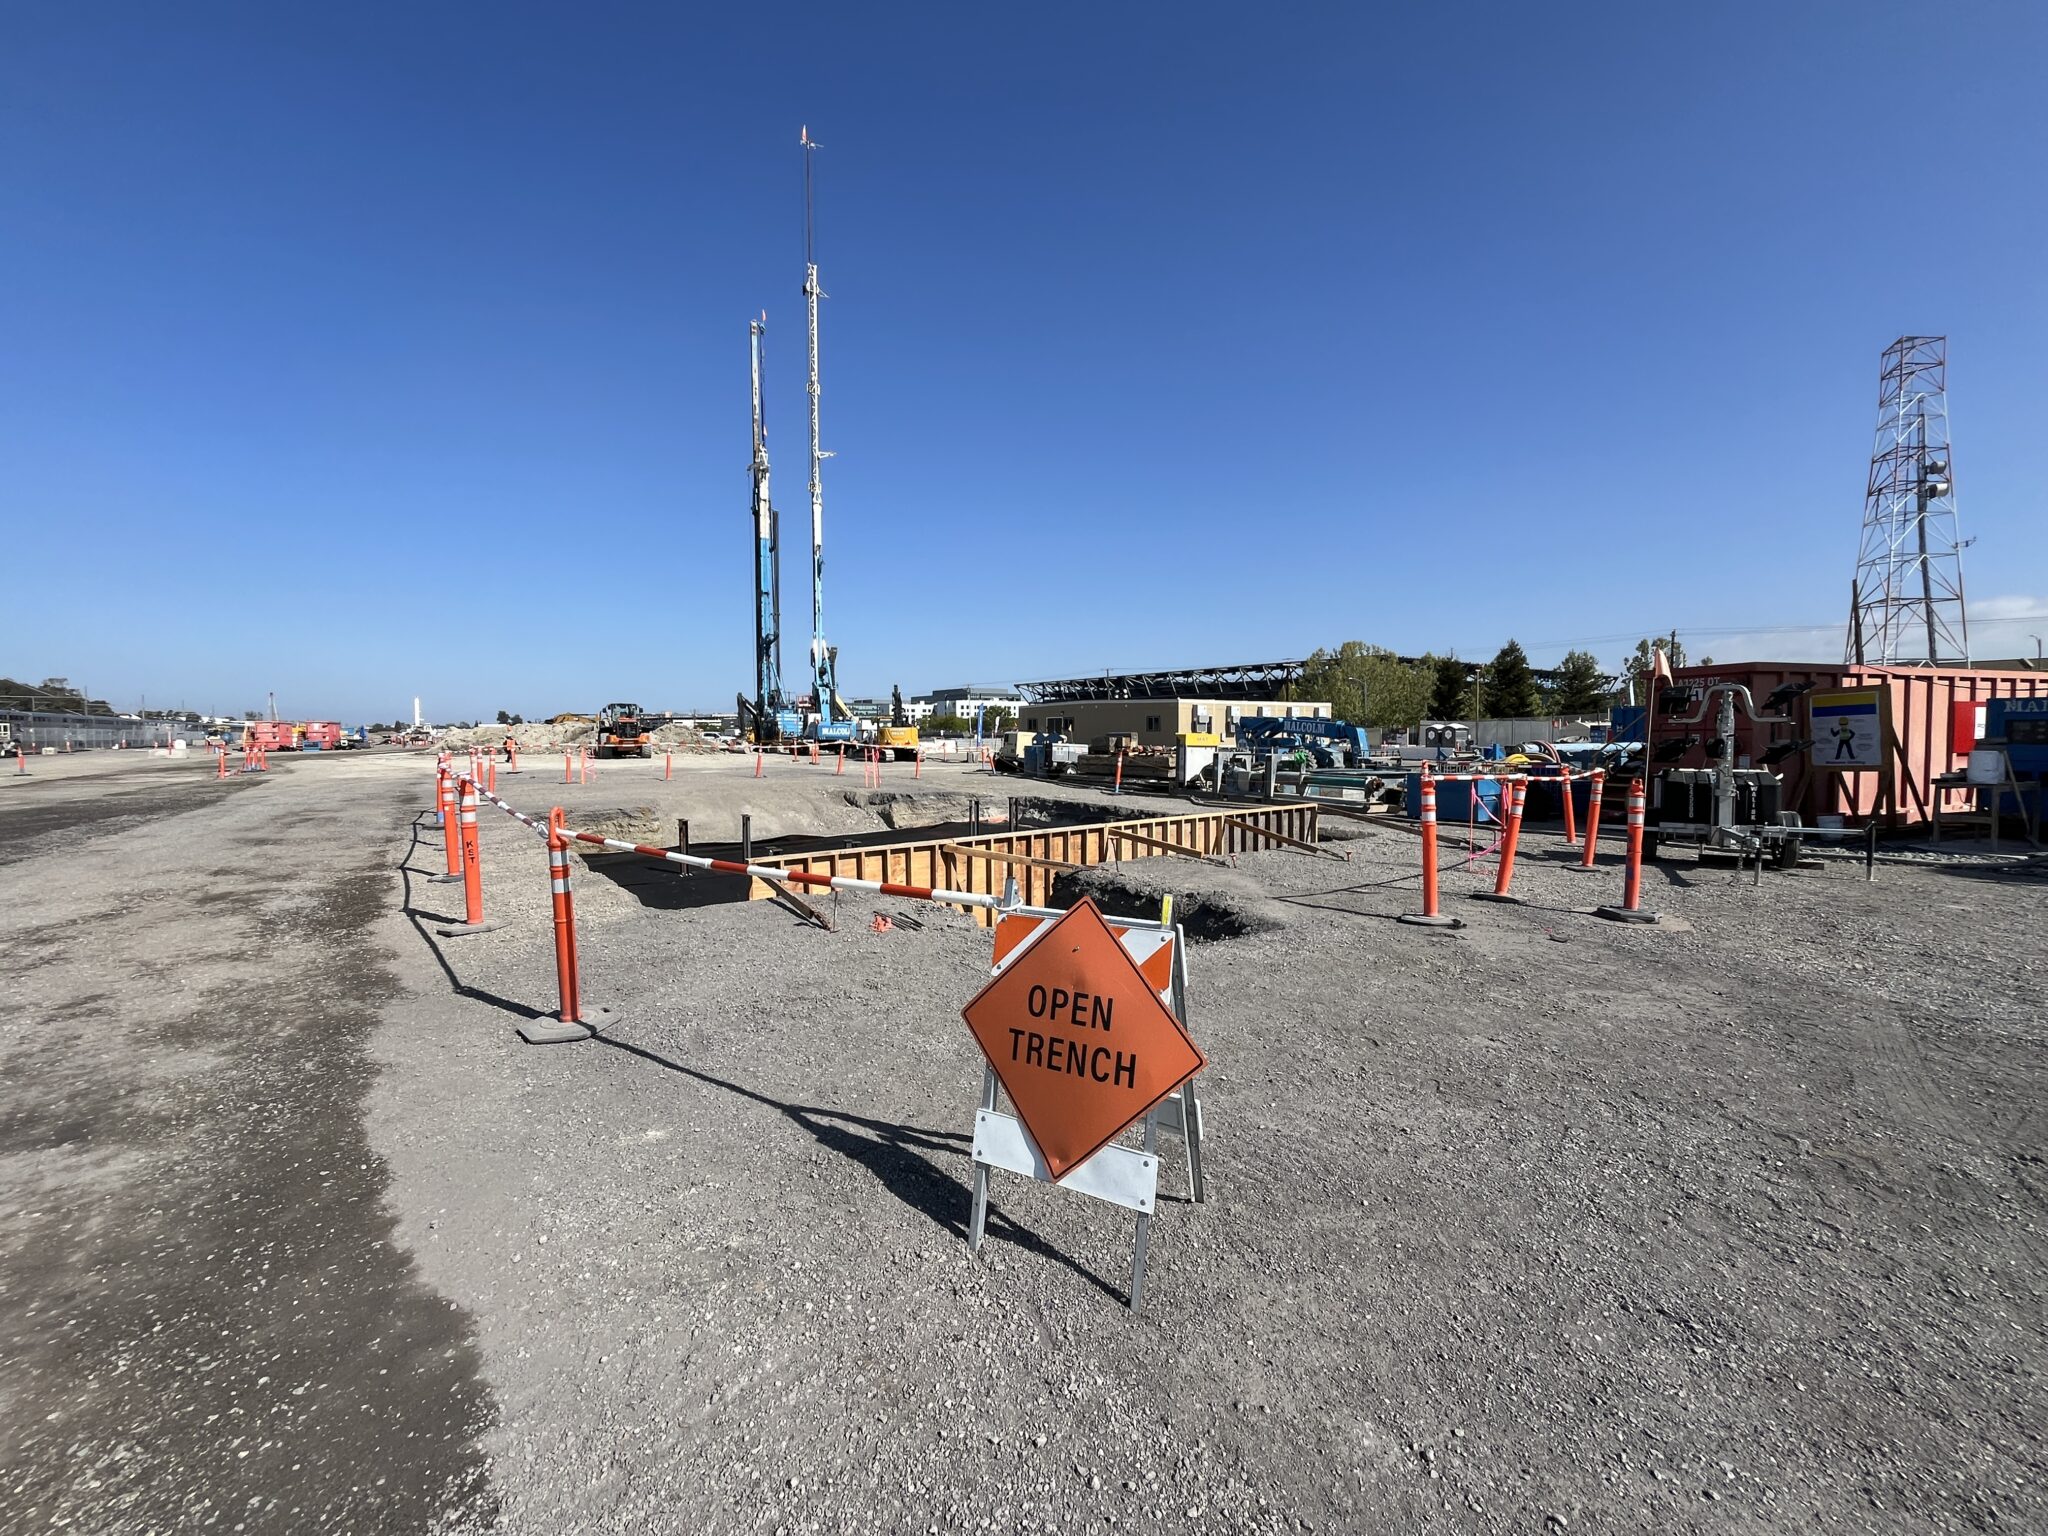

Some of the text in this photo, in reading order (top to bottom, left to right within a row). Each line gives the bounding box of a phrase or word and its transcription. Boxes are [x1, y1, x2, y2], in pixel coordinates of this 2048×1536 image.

[1283, 720, 1326, 734] MALCOLM
[1028, 984, 1113, 1032] OPEN
[1008, 1027, 1137, 1089] TRENCH
